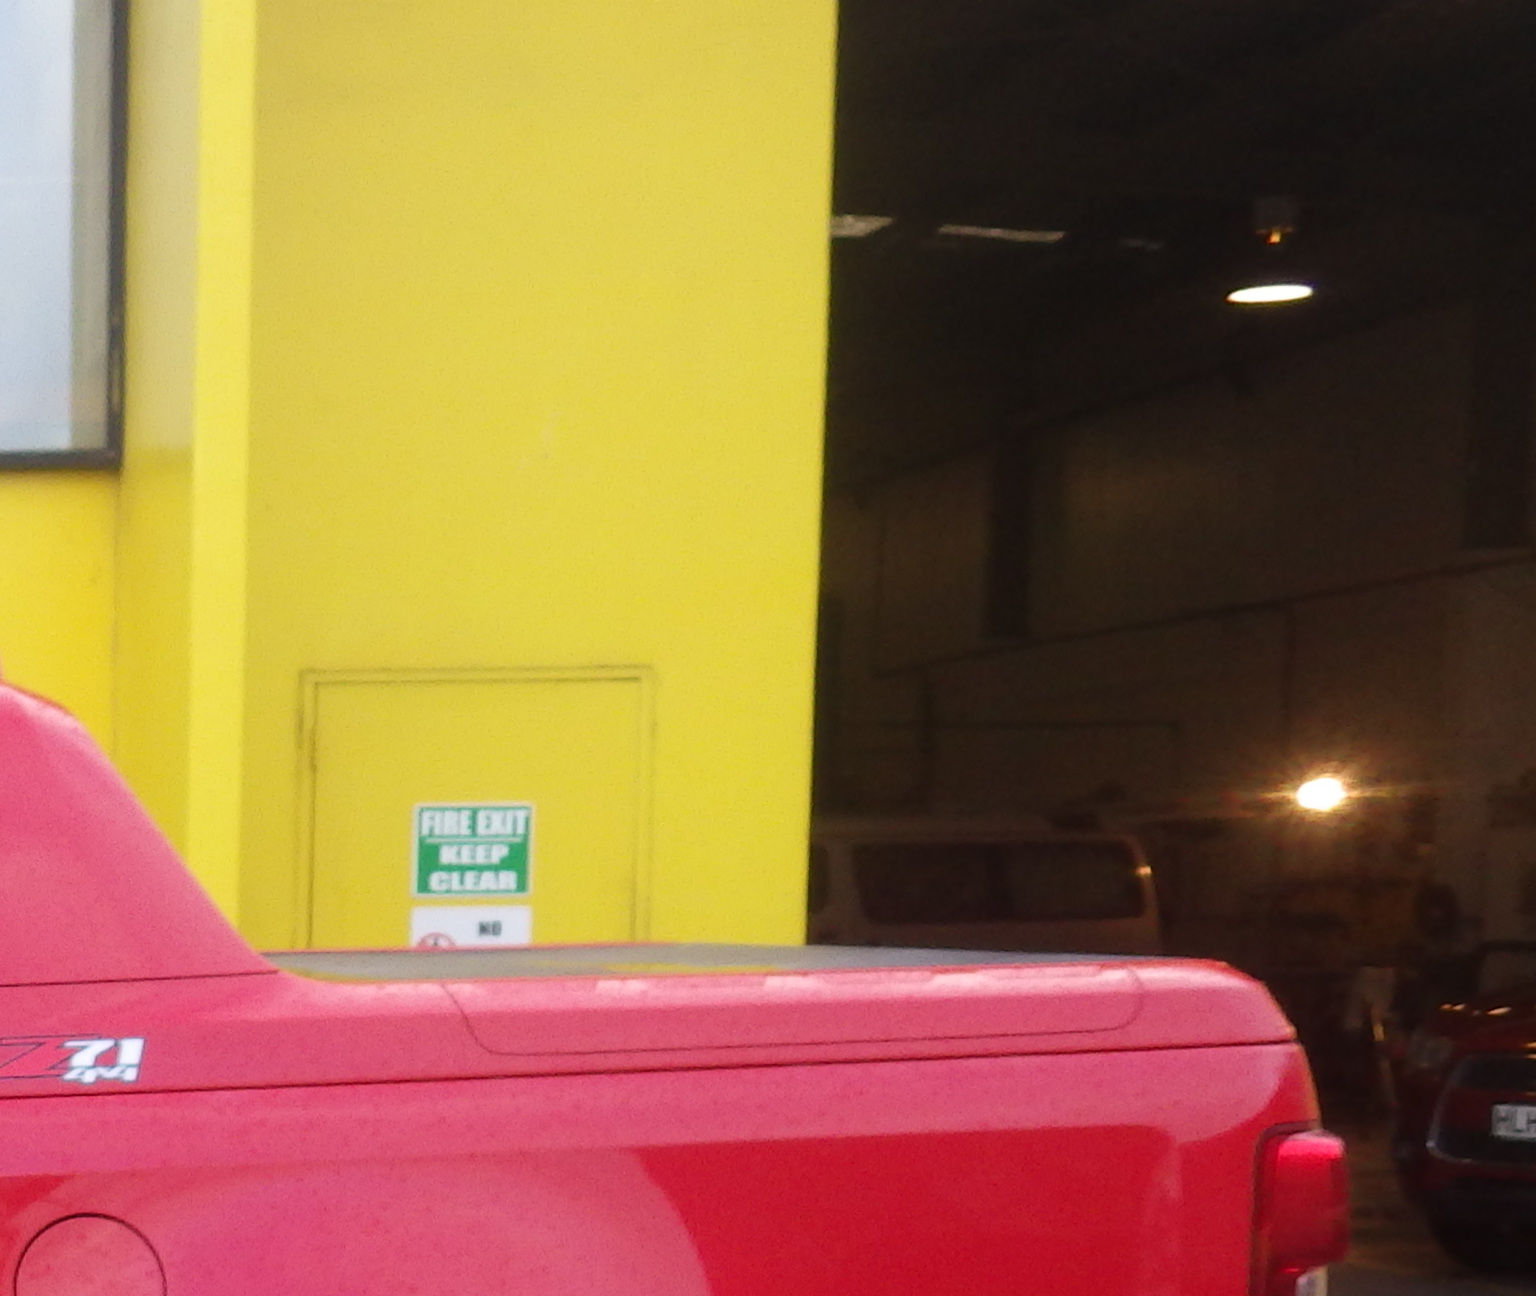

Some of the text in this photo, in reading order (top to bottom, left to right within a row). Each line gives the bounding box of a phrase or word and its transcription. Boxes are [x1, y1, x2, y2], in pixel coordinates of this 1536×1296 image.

[421, 809, 528, 836] FIRE EXIT
[439, 844, 510, 866] KEEP
[430, 871, 518, 891] CLEAR
[478, 921, 502, 937] NO
